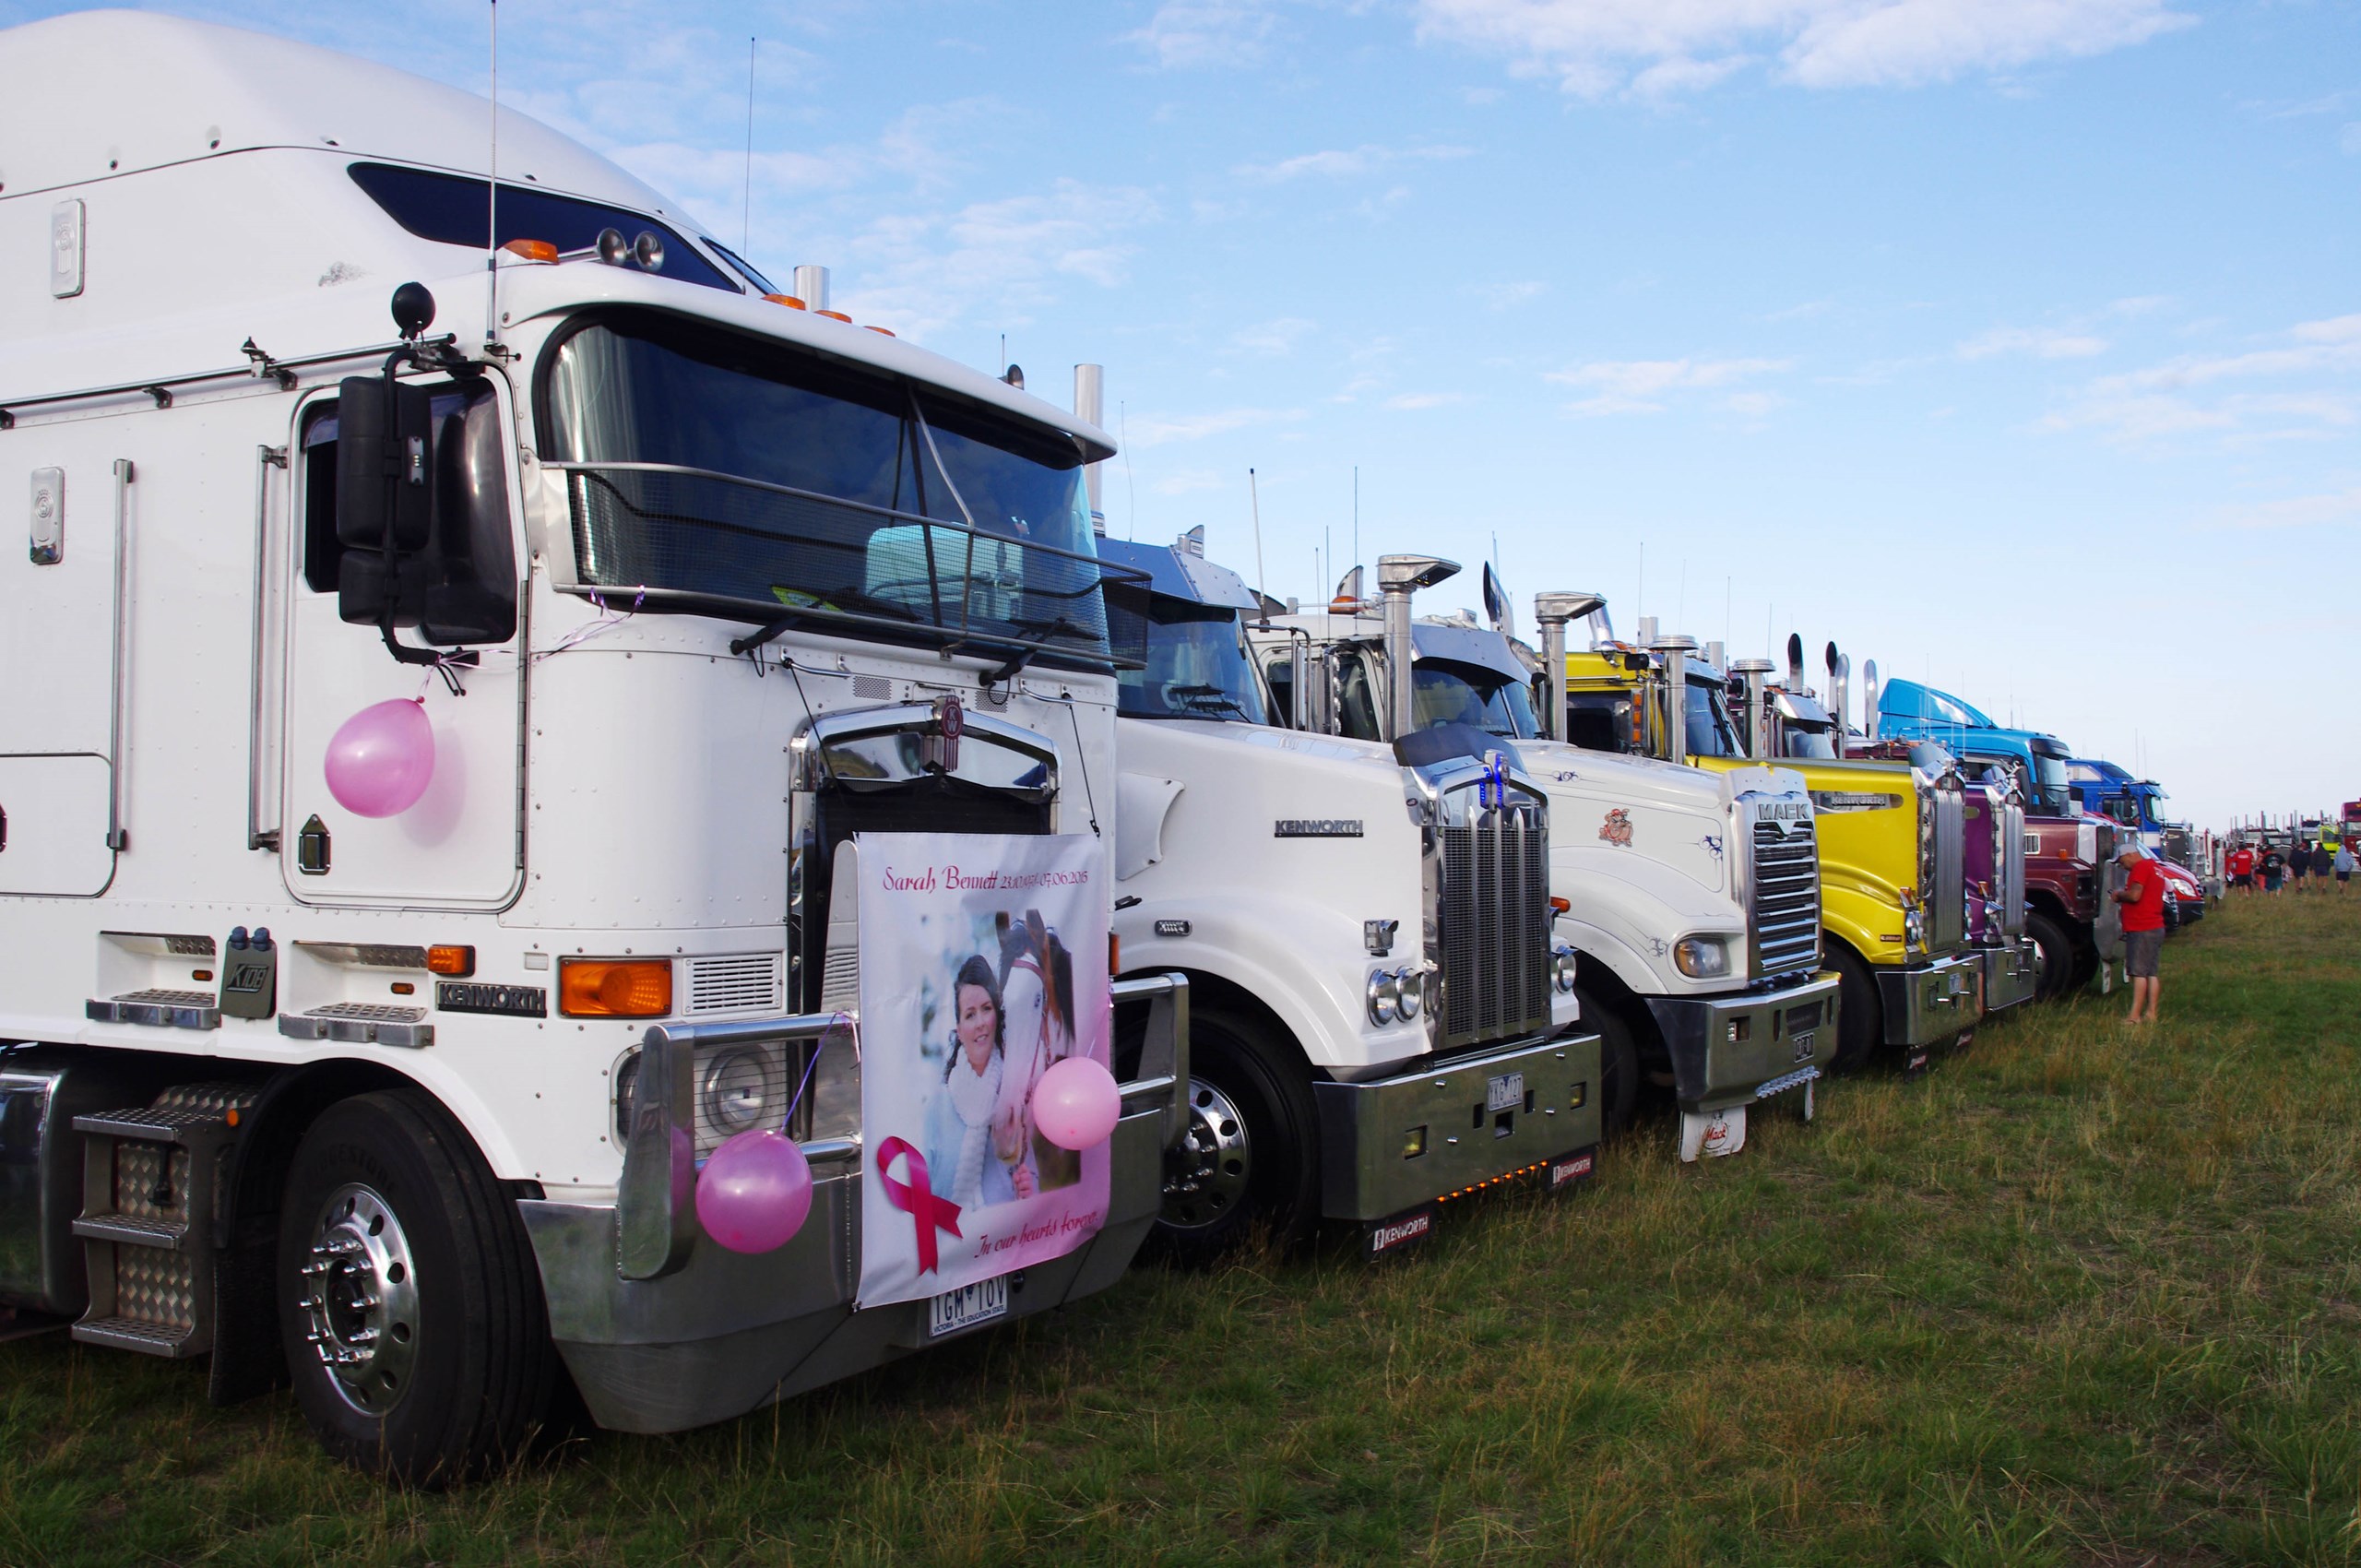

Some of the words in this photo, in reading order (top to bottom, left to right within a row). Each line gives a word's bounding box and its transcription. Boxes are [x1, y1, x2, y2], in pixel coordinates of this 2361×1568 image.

[1758, 803, 1810, 821] MACK
[1831, 794, 1886, 805] KENWORTH
[1275, 819, 1363, 834] KENWORTH
[883, 865, 937, 894] Sarah
[941, 864, 998, 890] Bennett
[228, 962, 269, 989] K108
[438, 982, 548, 1013] KENWORTH
[974, 1234, 991, 1259] In
[994, 1234, 1016, 1252] our
[1018, 1218, 1058, 1248] hearts
[1384, 1216, 1429, 1245] KENWORTH
[933, 1321, 954, 1333] VICTORIA
[967, 1310, 991, 1323] EDUCATION
